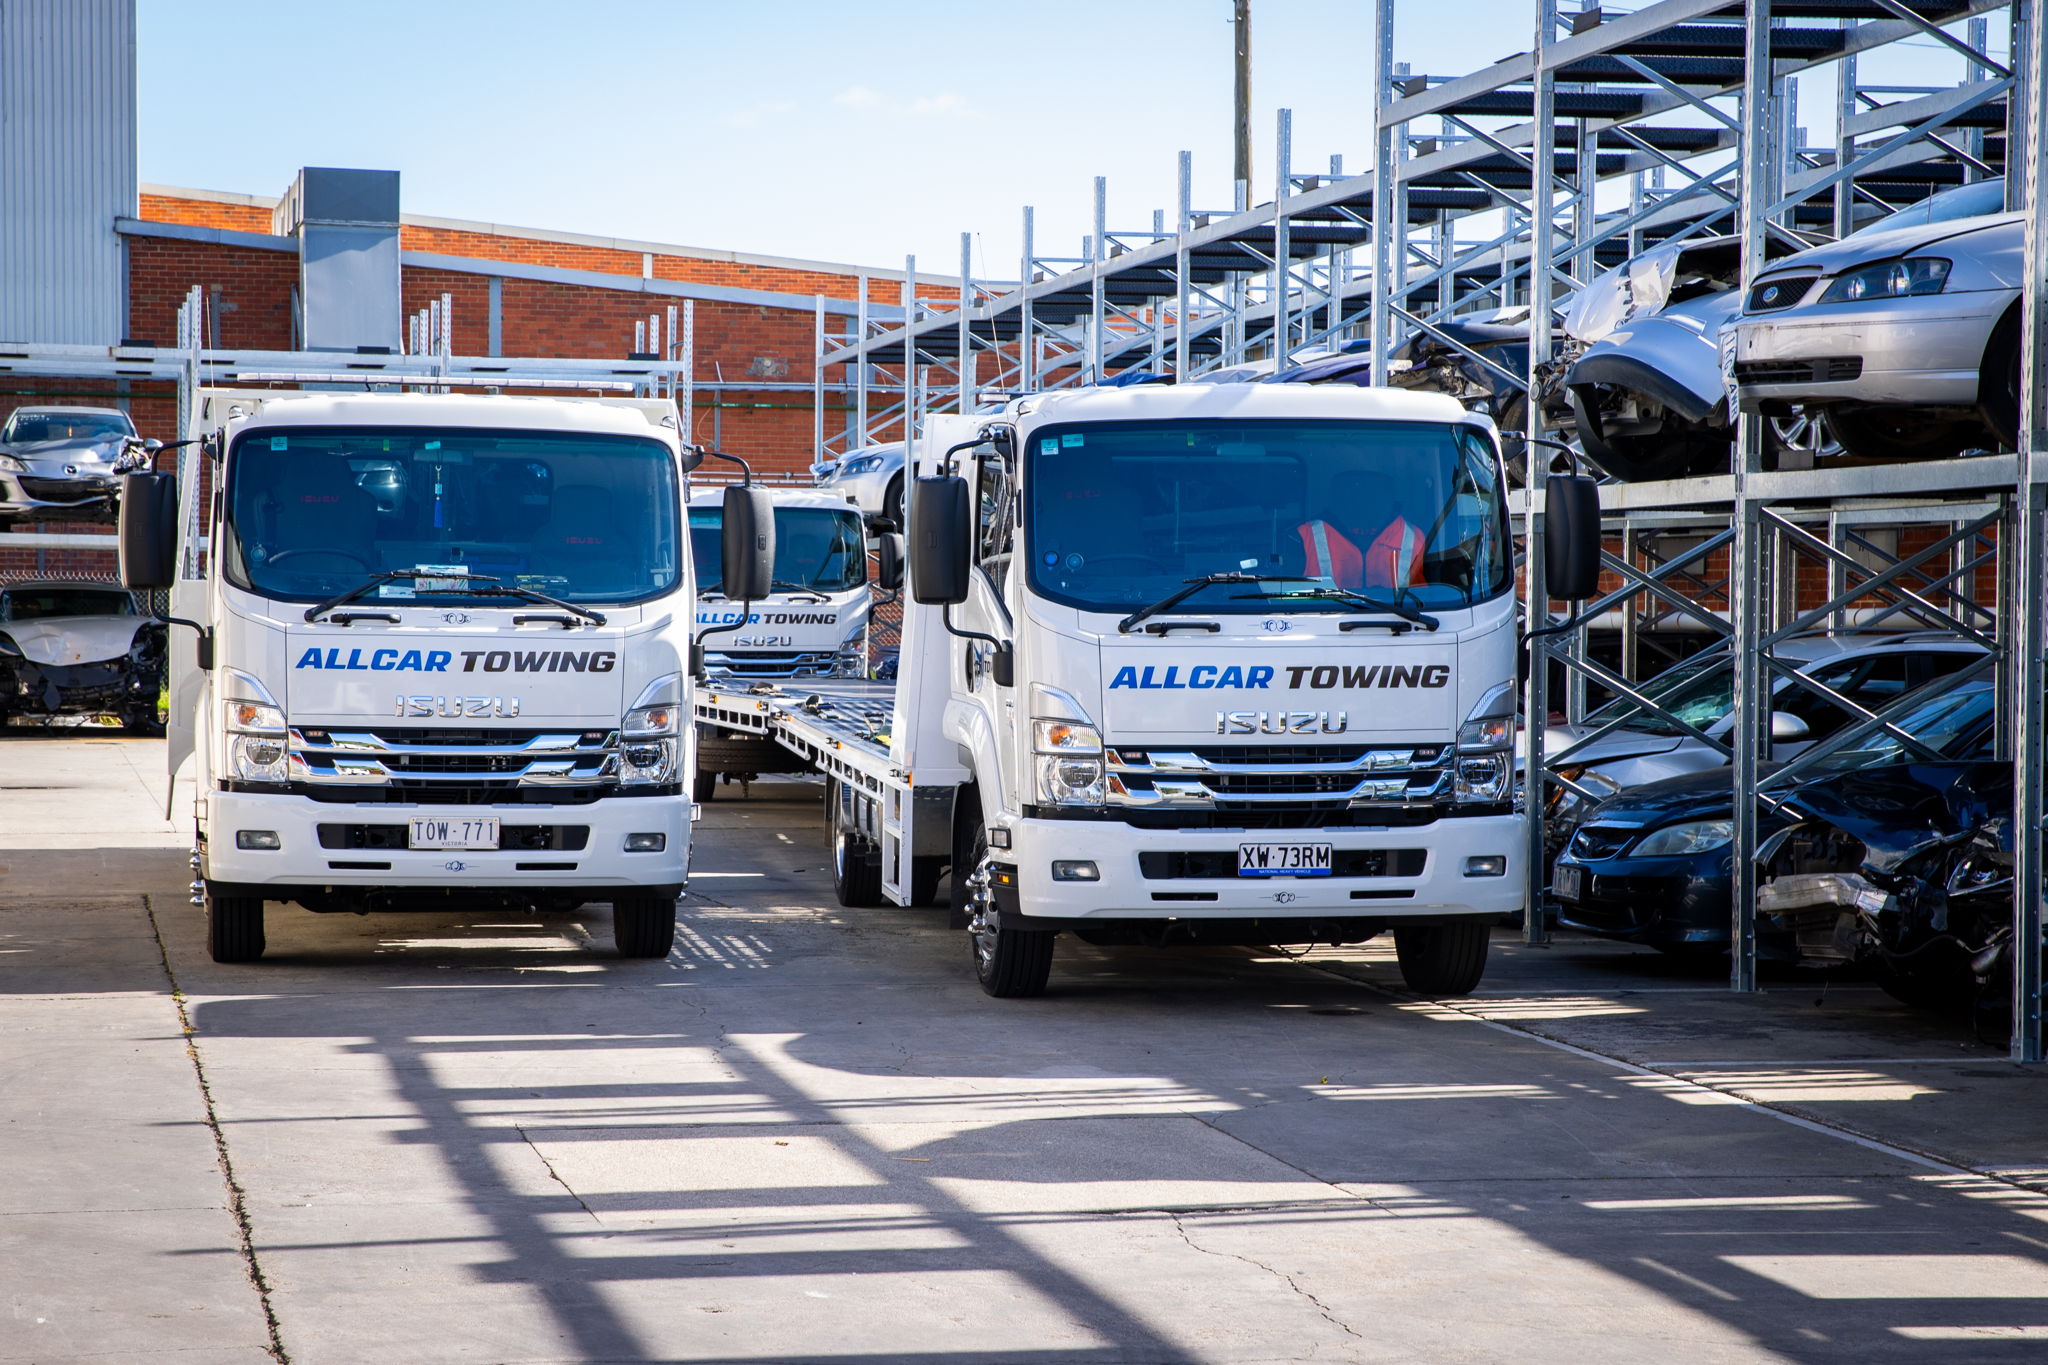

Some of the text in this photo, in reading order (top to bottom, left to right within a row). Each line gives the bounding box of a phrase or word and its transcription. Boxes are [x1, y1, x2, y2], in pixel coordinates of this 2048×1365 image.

[764, 614, 837, 624] TOWING
[734, 636, 791, 646] ISUZU
[295, 648, 615, 672] ALLCAR TOWING
[1109, 665, 1450, 689] ALLCAR TOWING
[395, 695, 520, 718] ISUZU
[1216, 711, 1348, 735] ISUZU
